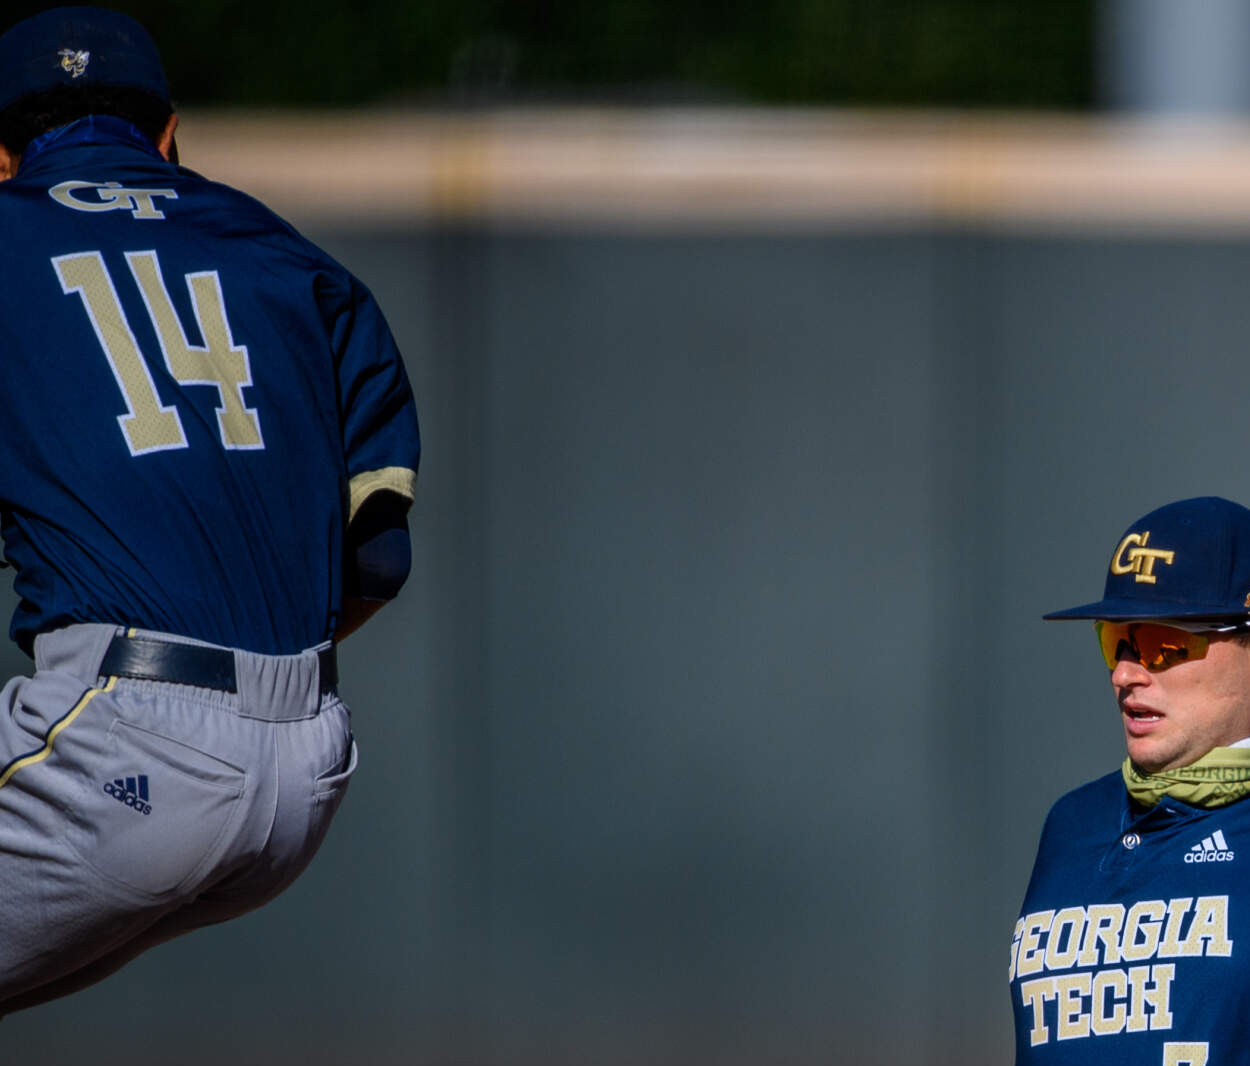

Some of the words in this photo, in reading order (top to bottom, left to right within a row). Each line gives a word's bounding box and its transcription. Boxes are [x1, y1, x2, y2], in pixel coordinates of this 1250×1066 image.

[48, 180, 179, 220] GT
[50, 249, 266, 457] 14
[1111, 530, 1176, 584] GT
[102, 782, 152, 815] adidas
[1183, 849, 1235, 864] adidas
[1021, 962, 1176, 1047] TECH
